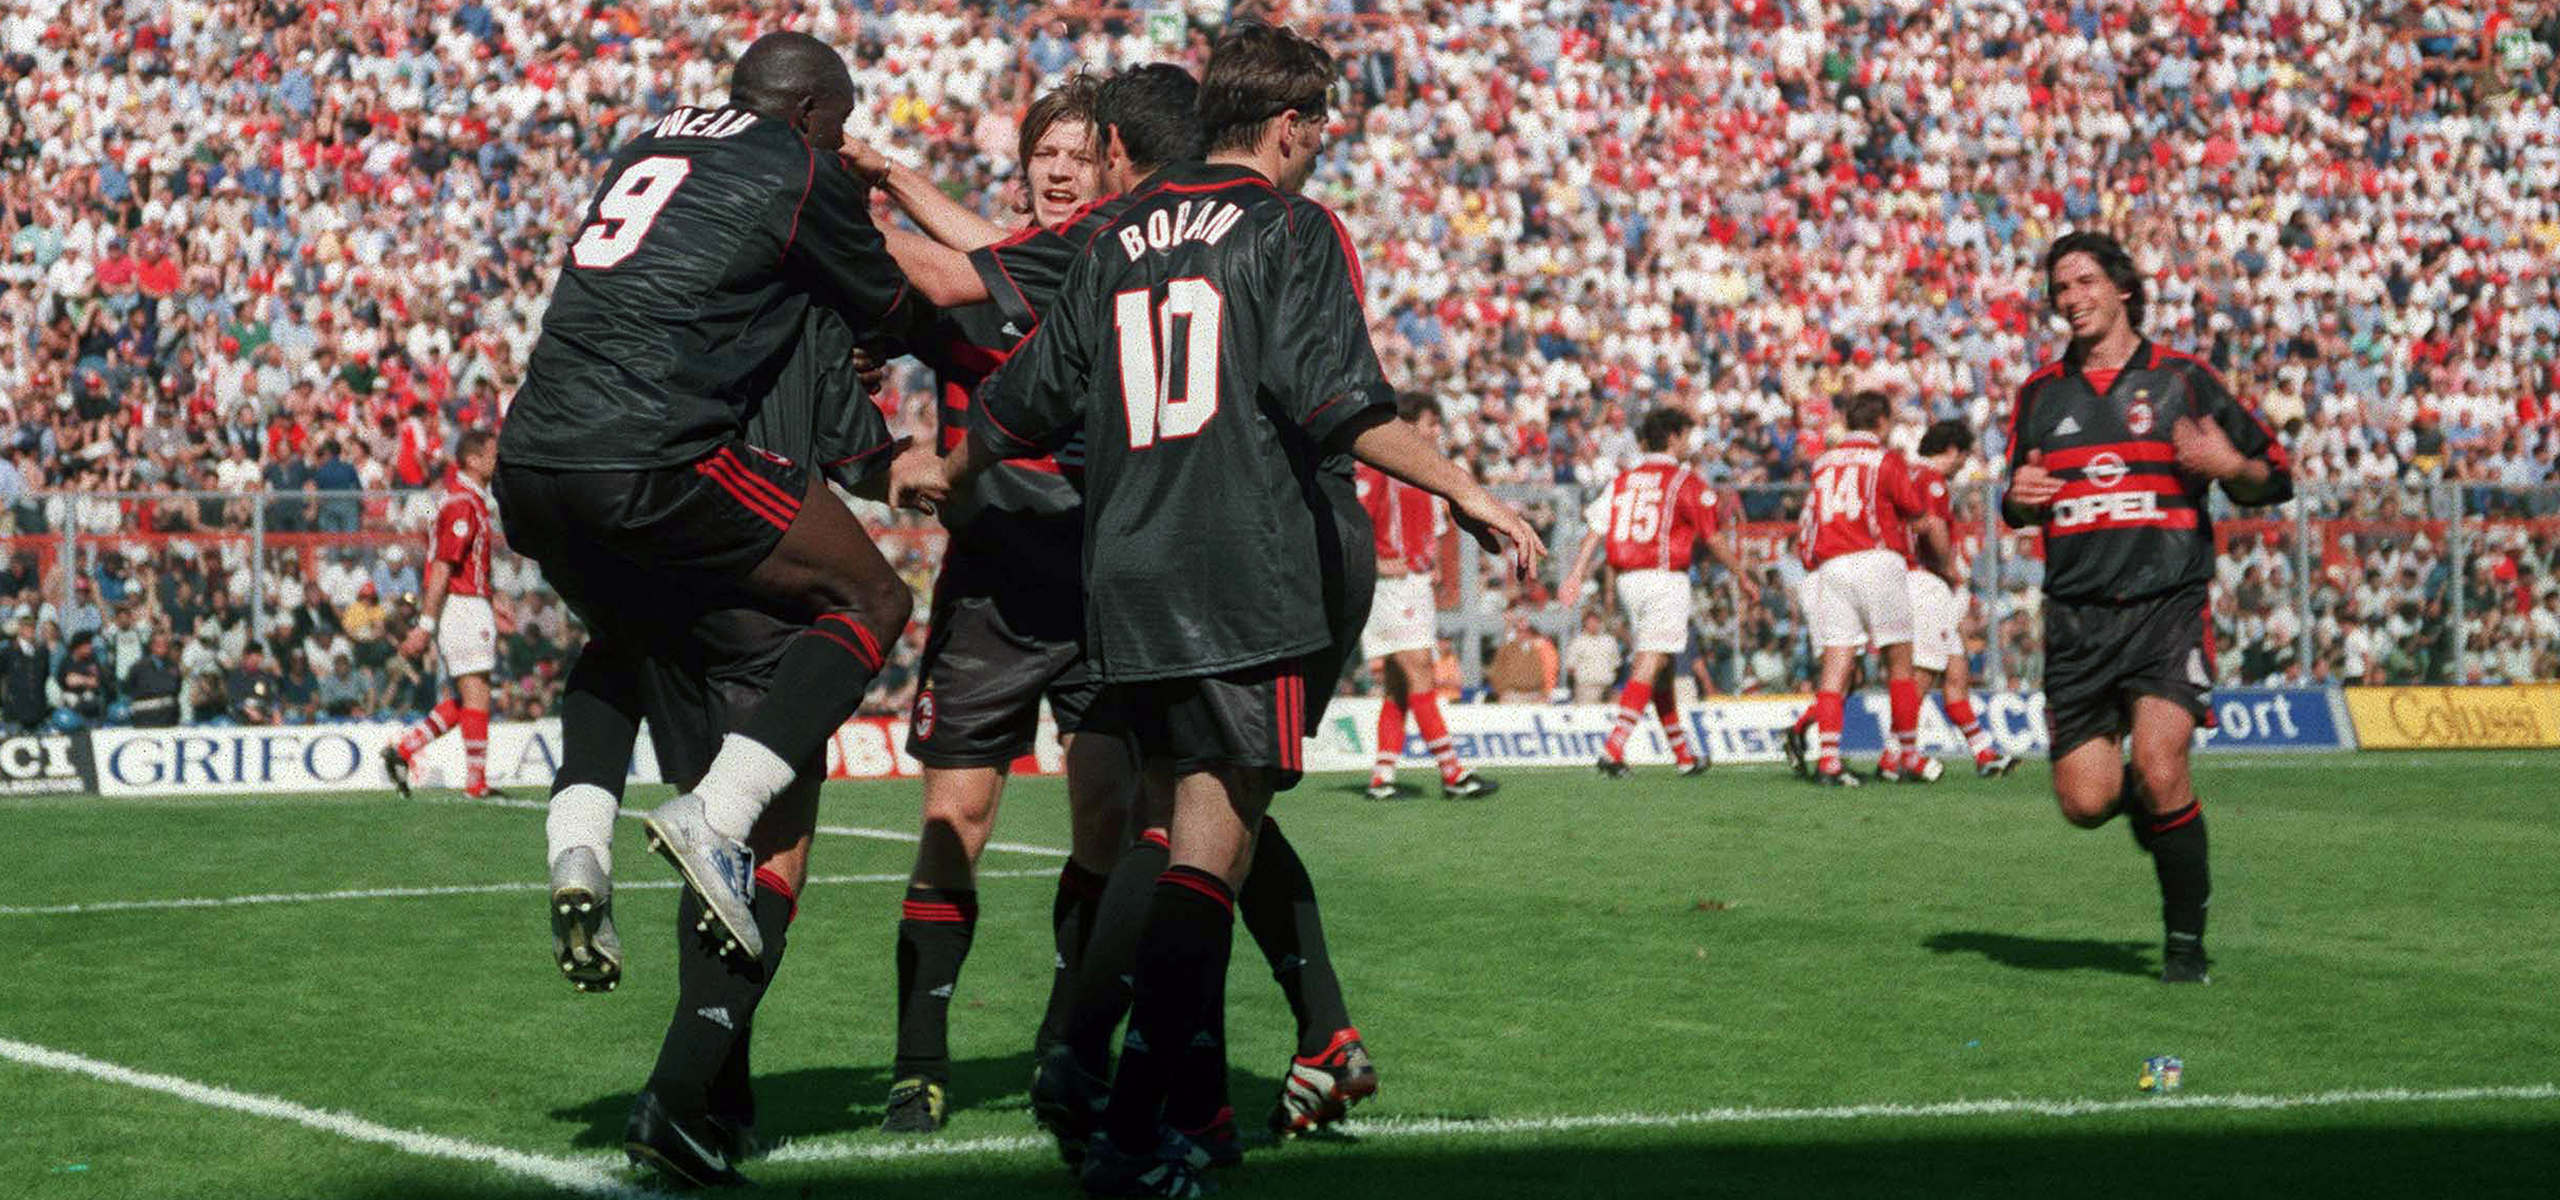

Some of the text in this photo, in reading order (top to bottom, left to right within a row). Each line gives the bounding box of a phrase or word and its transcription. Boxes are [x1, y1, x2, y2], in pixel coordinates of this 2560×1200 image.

[571, 154, 692, 269] 9
[1114, 275, 1223, 451] 10
[1615, 488, 1663, 542] 15
[1815, 465, 1863, 521] 14
[2052, 491, 2168, 527] OPEL
[109, 735, 361, 786] GRIFO
